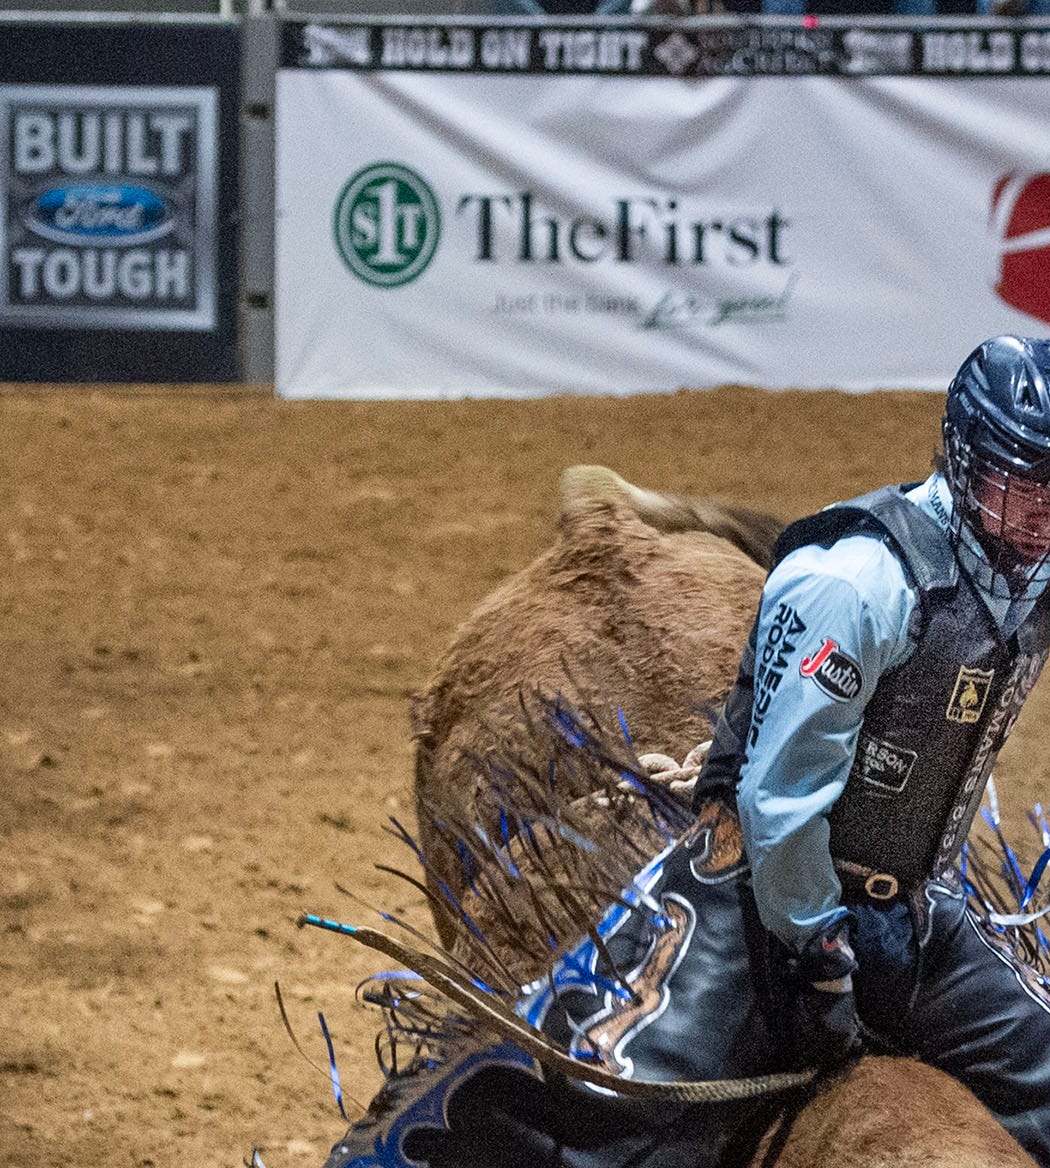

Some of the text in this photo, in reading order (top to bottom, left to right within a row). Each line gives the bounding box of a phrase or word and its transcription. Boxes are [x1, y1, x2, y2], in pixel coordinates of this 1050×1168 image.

[480, 28, 531, 69] ON
[14, 114, 191, 175] BUILT
[54, 192, 147, 229] Ford
[12, 249, 189, 298] TOUGH
[801, 638, 861, 699] Justin
